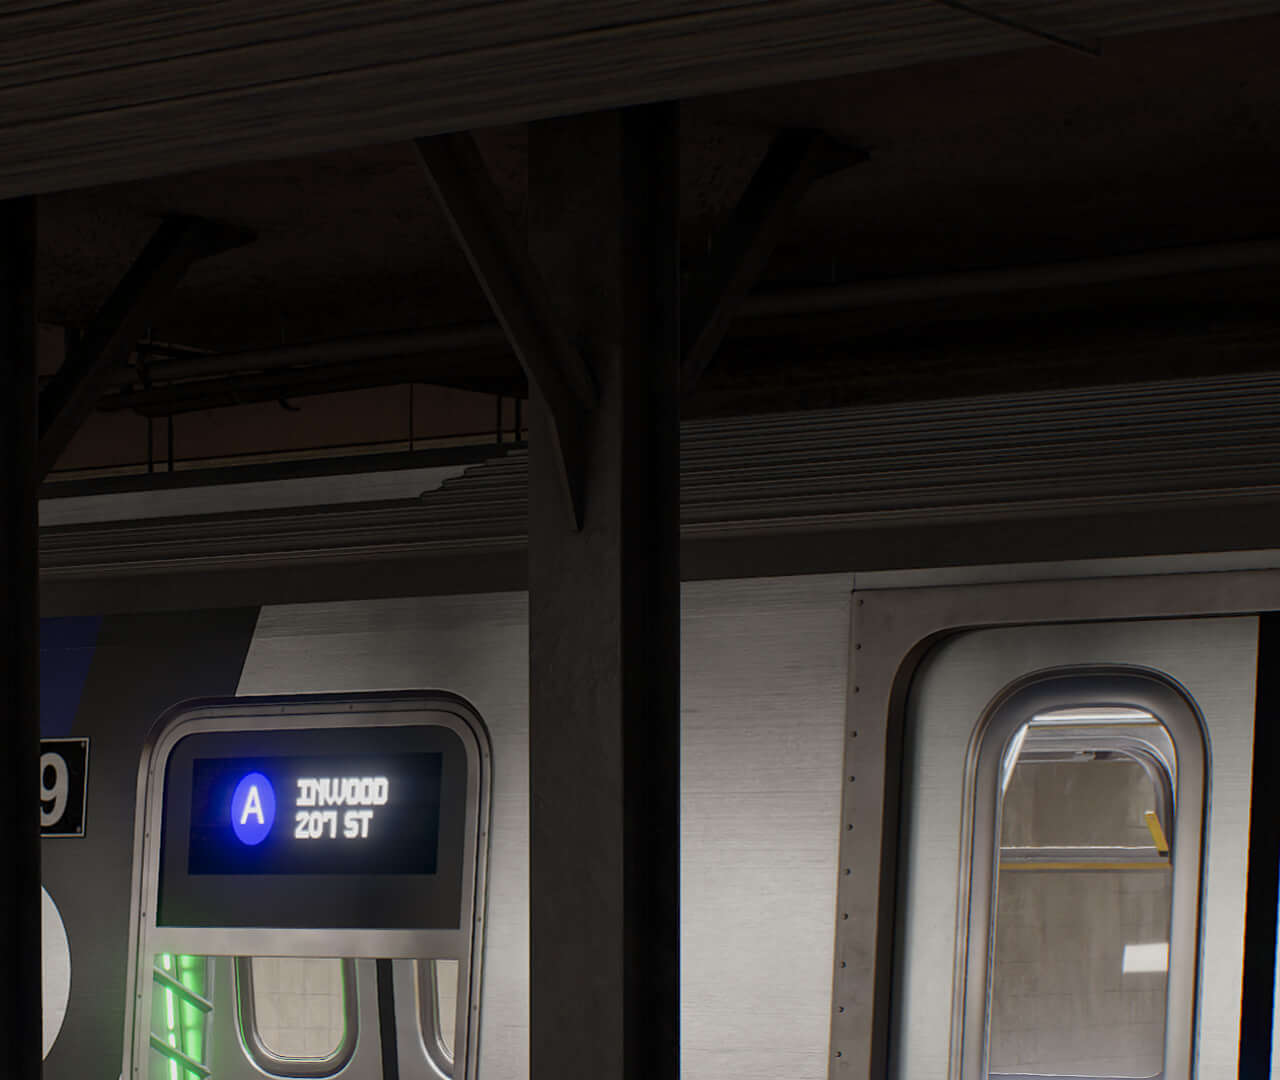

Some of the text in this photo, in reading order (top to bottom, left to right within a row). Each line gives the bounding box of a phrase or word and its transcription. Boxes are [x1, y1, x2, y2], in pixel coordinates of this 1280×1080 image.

[240, 785, 265, 825] A
[296, 776, 389, 807] INWOOD
[294, 809, 374, 839] 207 ST
